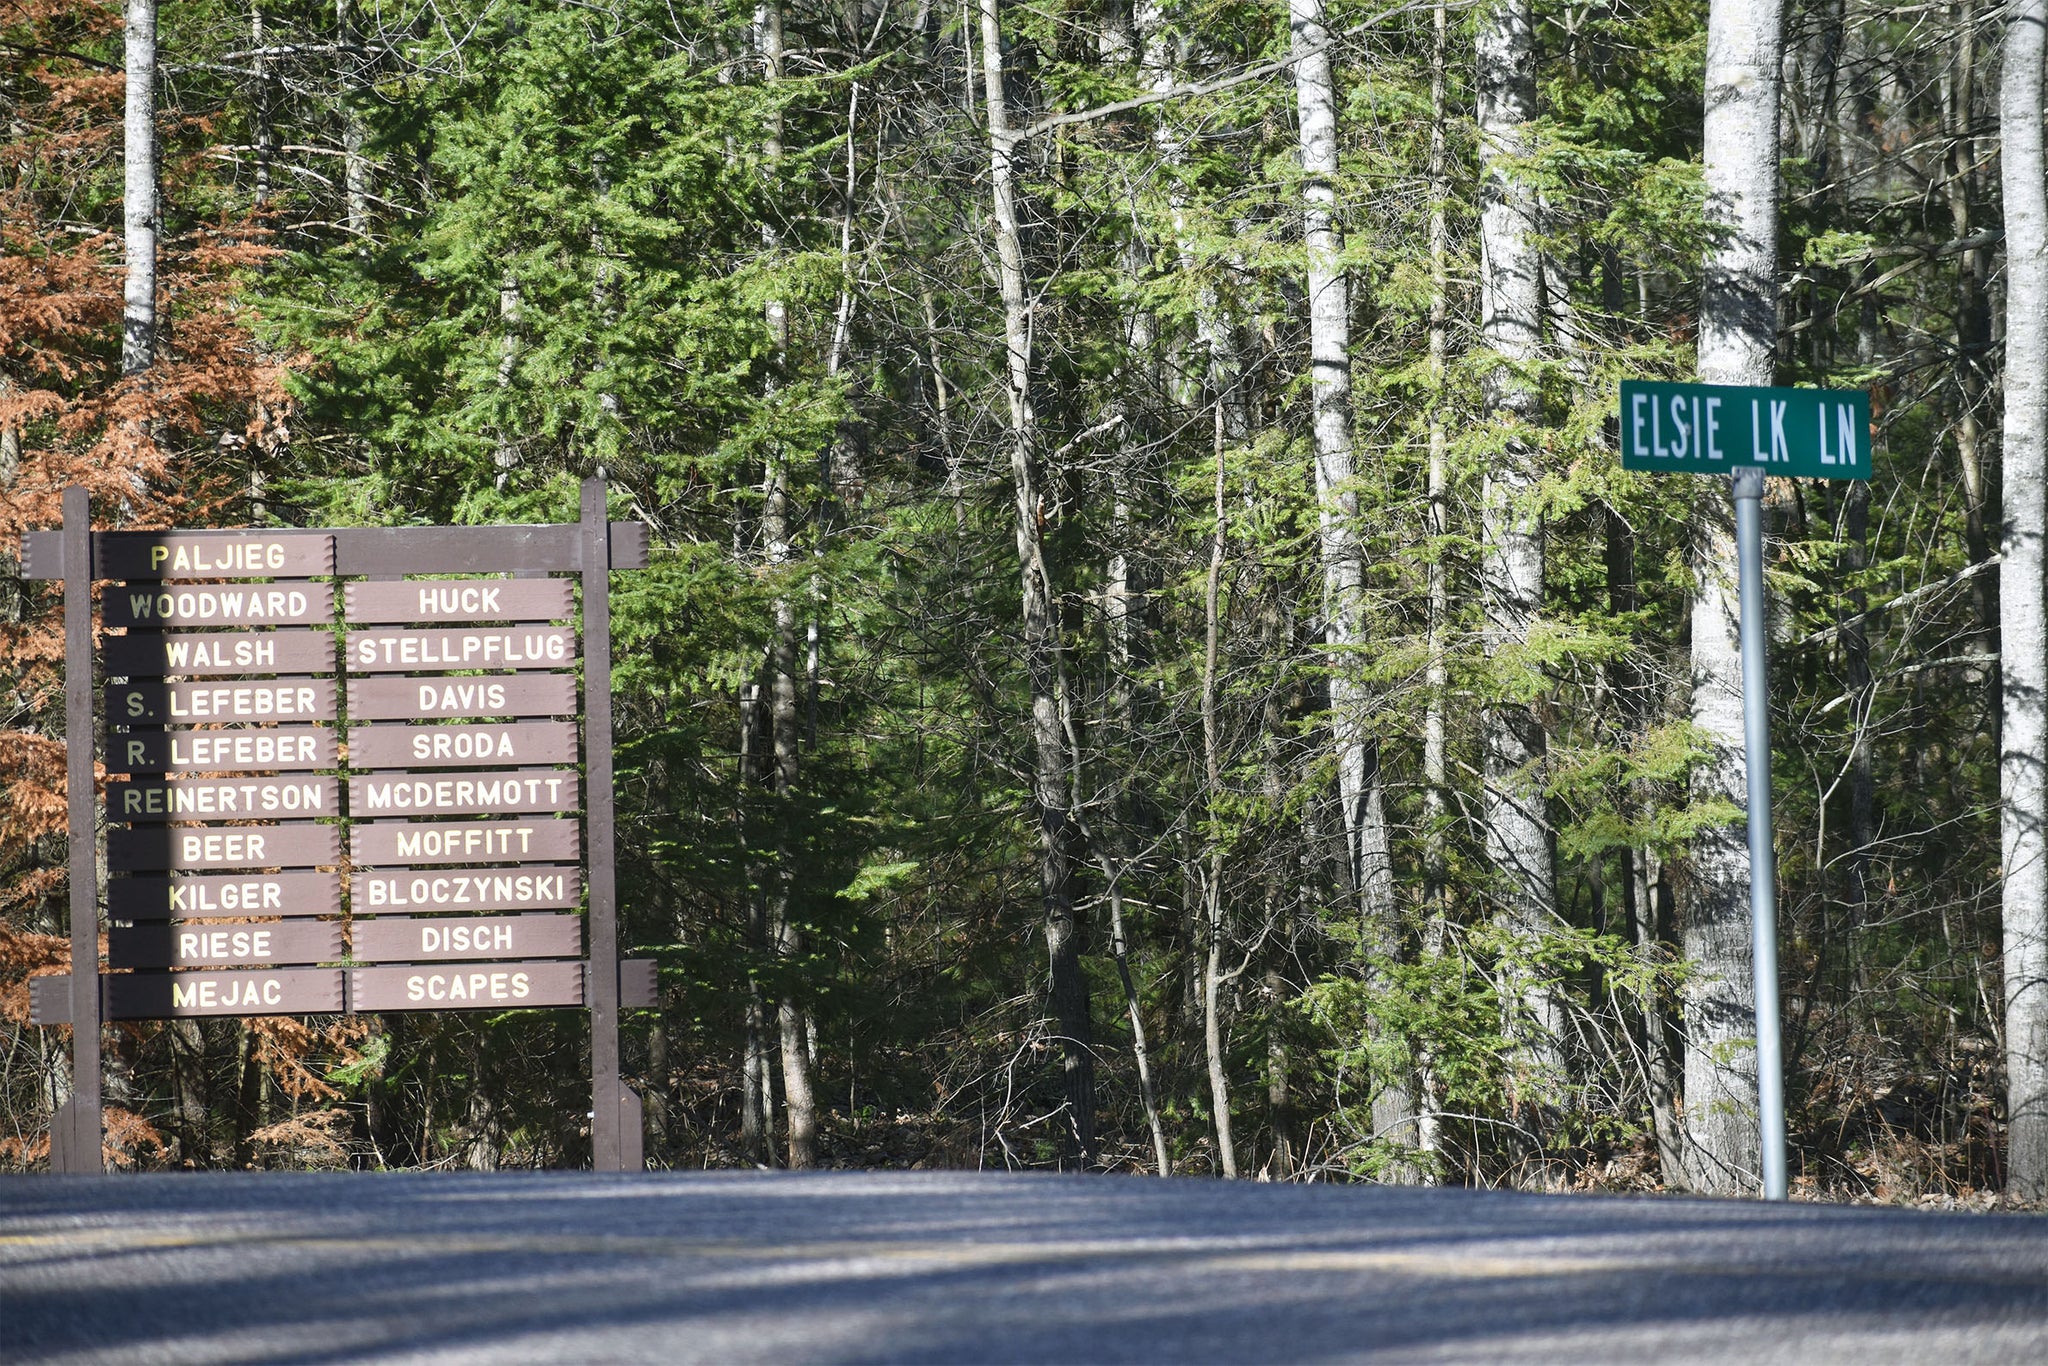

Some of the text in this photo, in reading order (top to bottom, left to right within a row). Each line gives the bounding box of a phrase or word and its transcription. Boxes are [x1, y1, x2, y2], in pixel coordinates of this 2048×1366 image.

[1632, 393, 1856, 465] ELSIE LK LN
[151, 544, 285, 570] PALJIEG
[130, 592, 307, 619] WOODWARD
[420, 588, 501, 614] HUCK
[166, 640, 275, 668] WALSH
[358, 636, 565, 665] STELLPFLUG
[126, 687, 316, 717] S. LEFEBER
[419, 685, 505, 711] DAVIS
[128, 735, 317, 765] R. LEFEBER
[413, 733, 515, 758] SRODA
[124, 785, 322, 814] REINERTSON
[368, 779, 562, 808] MCDERMOTT
[183, 835, 265, 862] BEER
[397, 829, 533, 857] MOFFITT
[169, 882, 281, 911] KILGER
[368, 876, 563, 905] BLOCZYNSKI
[180, 931, 271, 959] RIESE
[422, 925, 513, 952] DISCH
[173, 980, 282, 1008] MEJAC
[407, 973, 530, 1001] SCAPES
